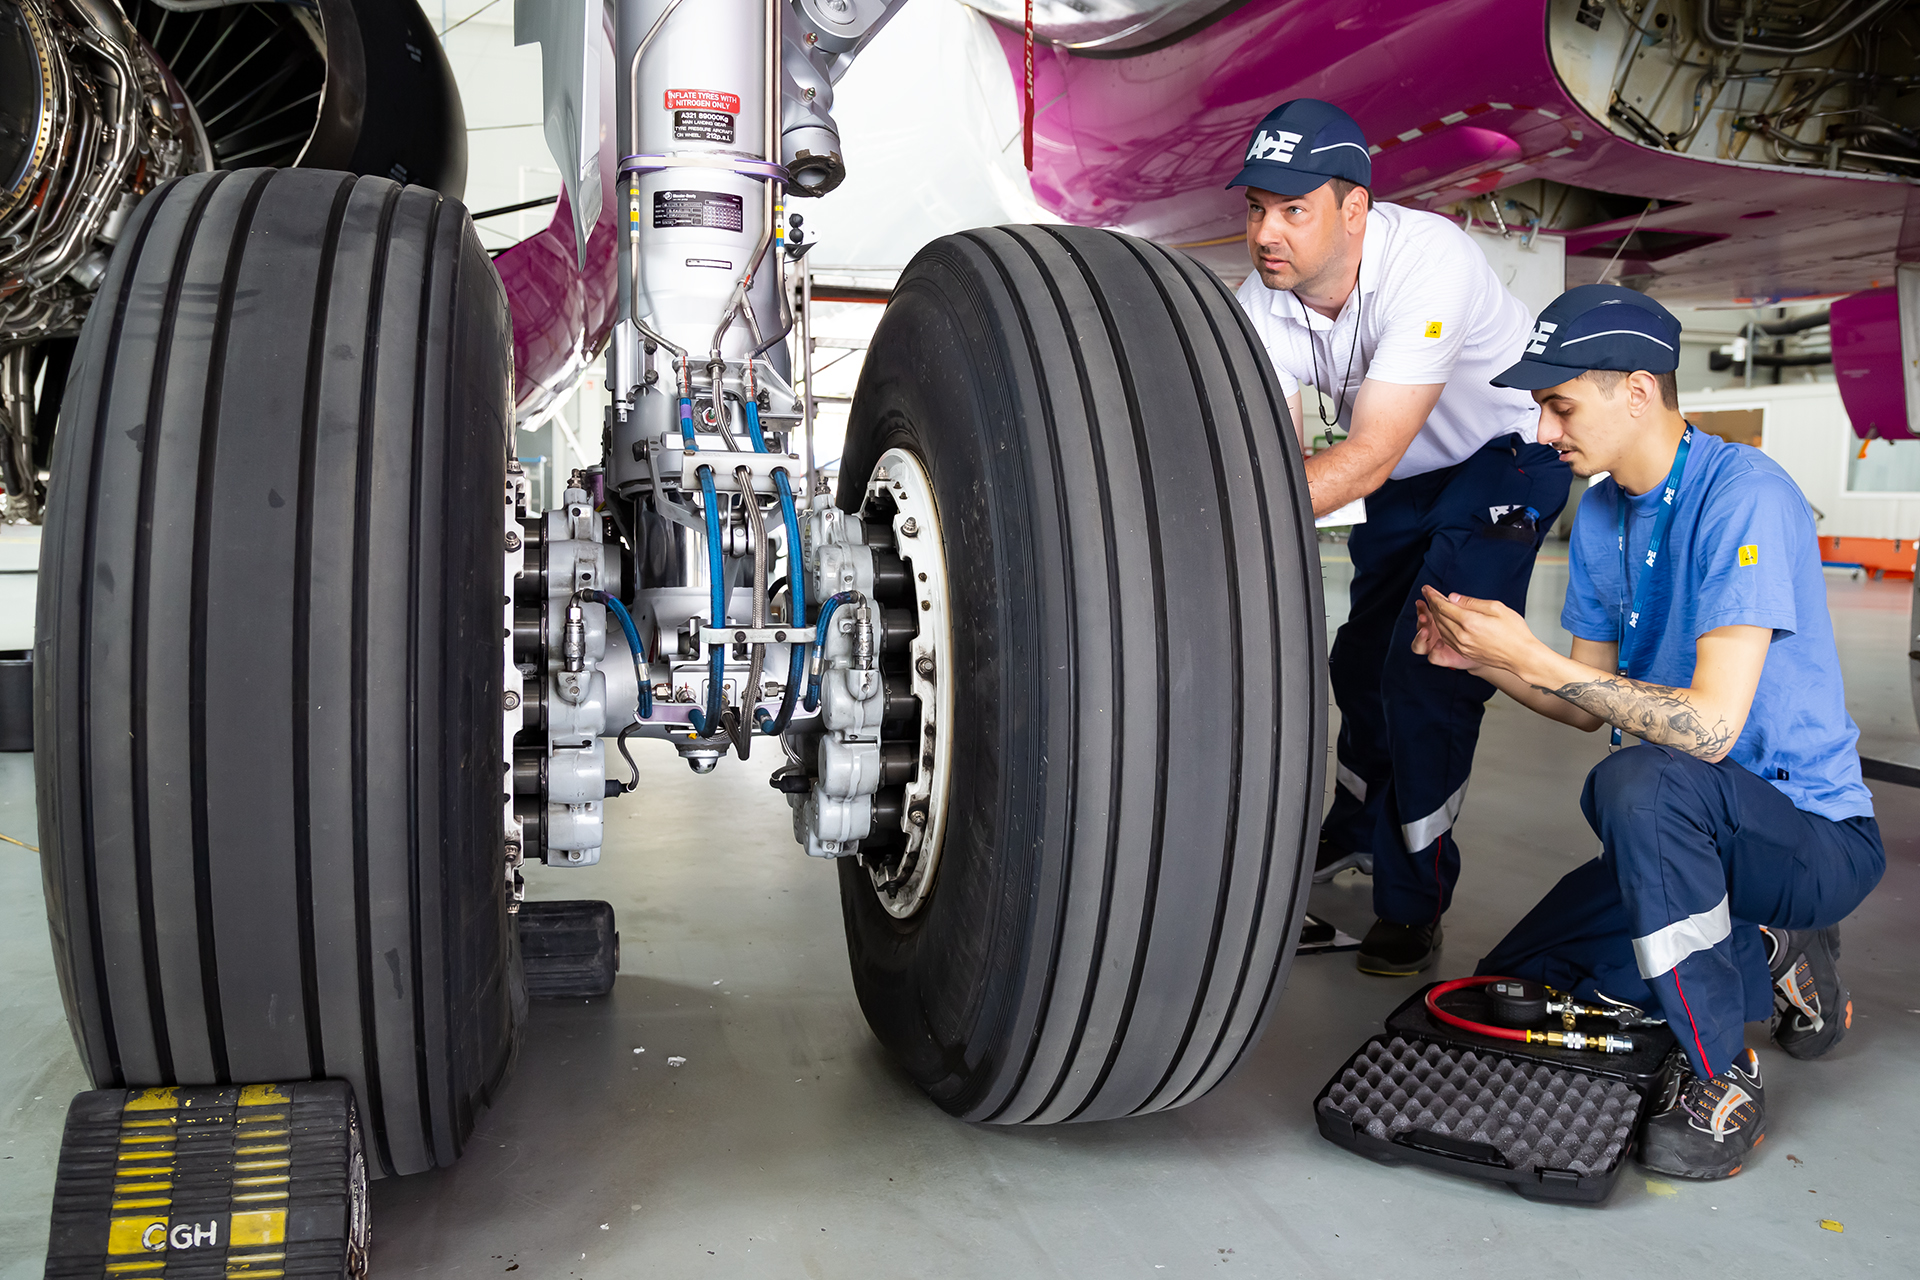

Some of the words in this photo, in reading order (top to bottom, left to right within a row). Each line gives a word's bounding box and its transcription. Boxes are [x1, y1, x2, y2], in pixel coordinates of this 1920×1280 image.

[668, 91, 697, 99] INFLATE
[698, 92, 719, 100] TYRES
[720, 95, 737, 104] WITH
[675, 99, 711, 107] NITROGEN
[711, 101, 730, 110] ONLY
[142, 1219, 217, 1251] CGH
